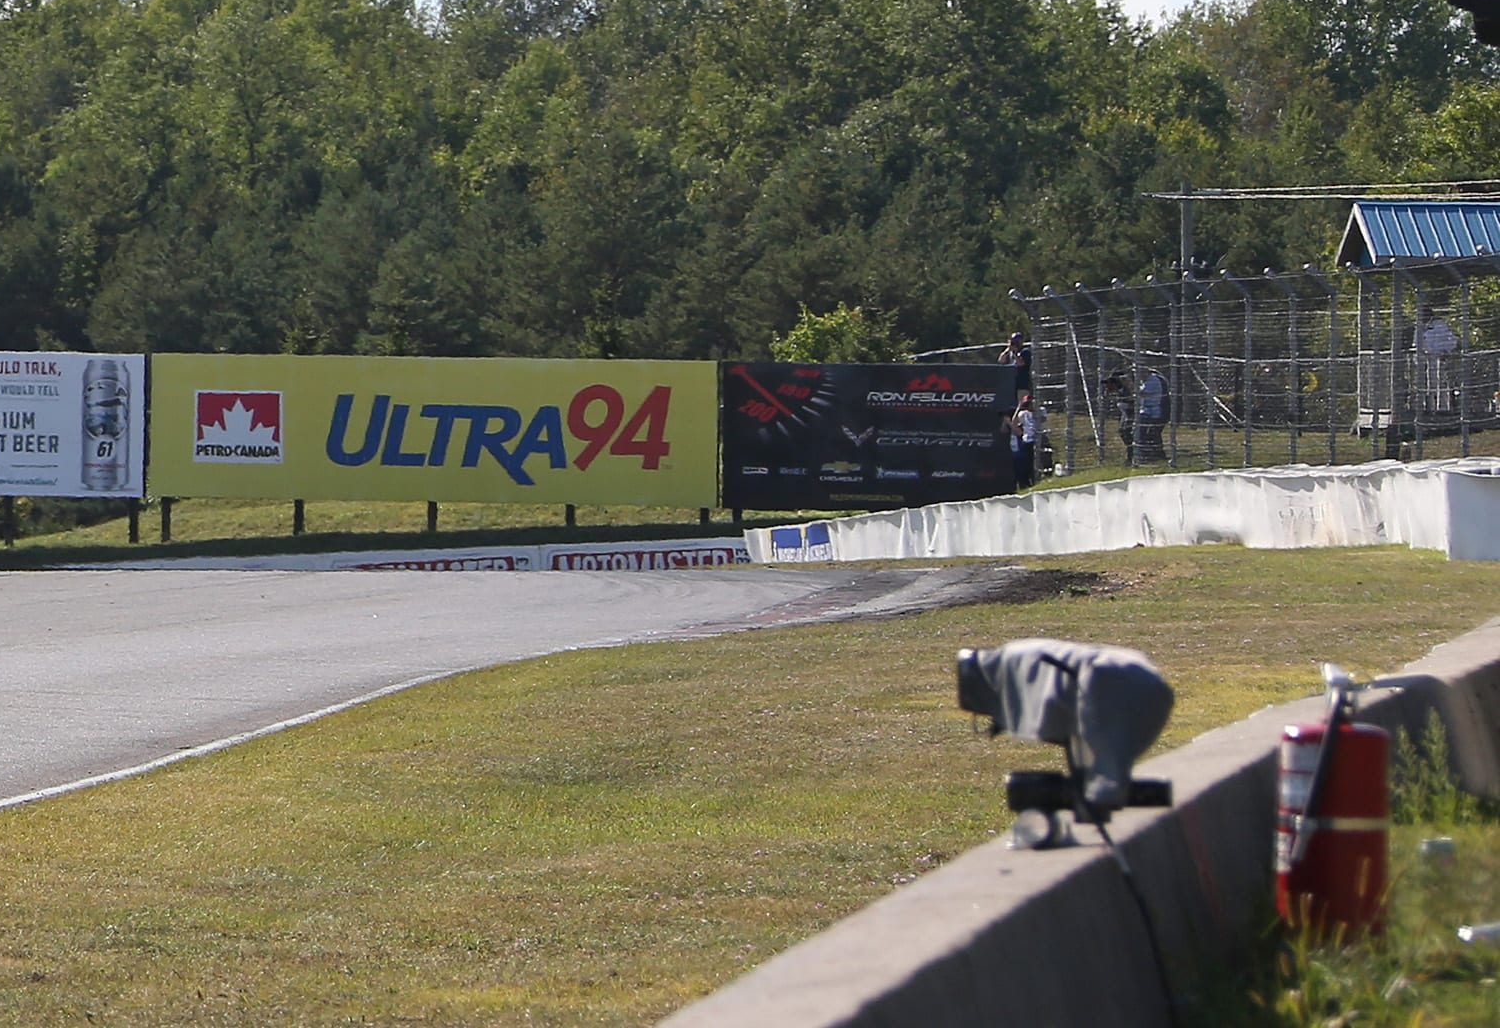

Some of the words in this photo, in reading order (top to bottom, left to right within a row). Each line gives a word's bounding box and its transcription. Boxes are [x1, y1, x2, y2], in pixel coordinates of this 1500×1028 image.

[867, 391, 907, 402] RON
[908, 392, 997, 403] FELLOWS
[12, 434, 60, 454] BEER
[97, 441, 114, 458] 61
[196, 444, 280, 458] PETRO-CANADA
